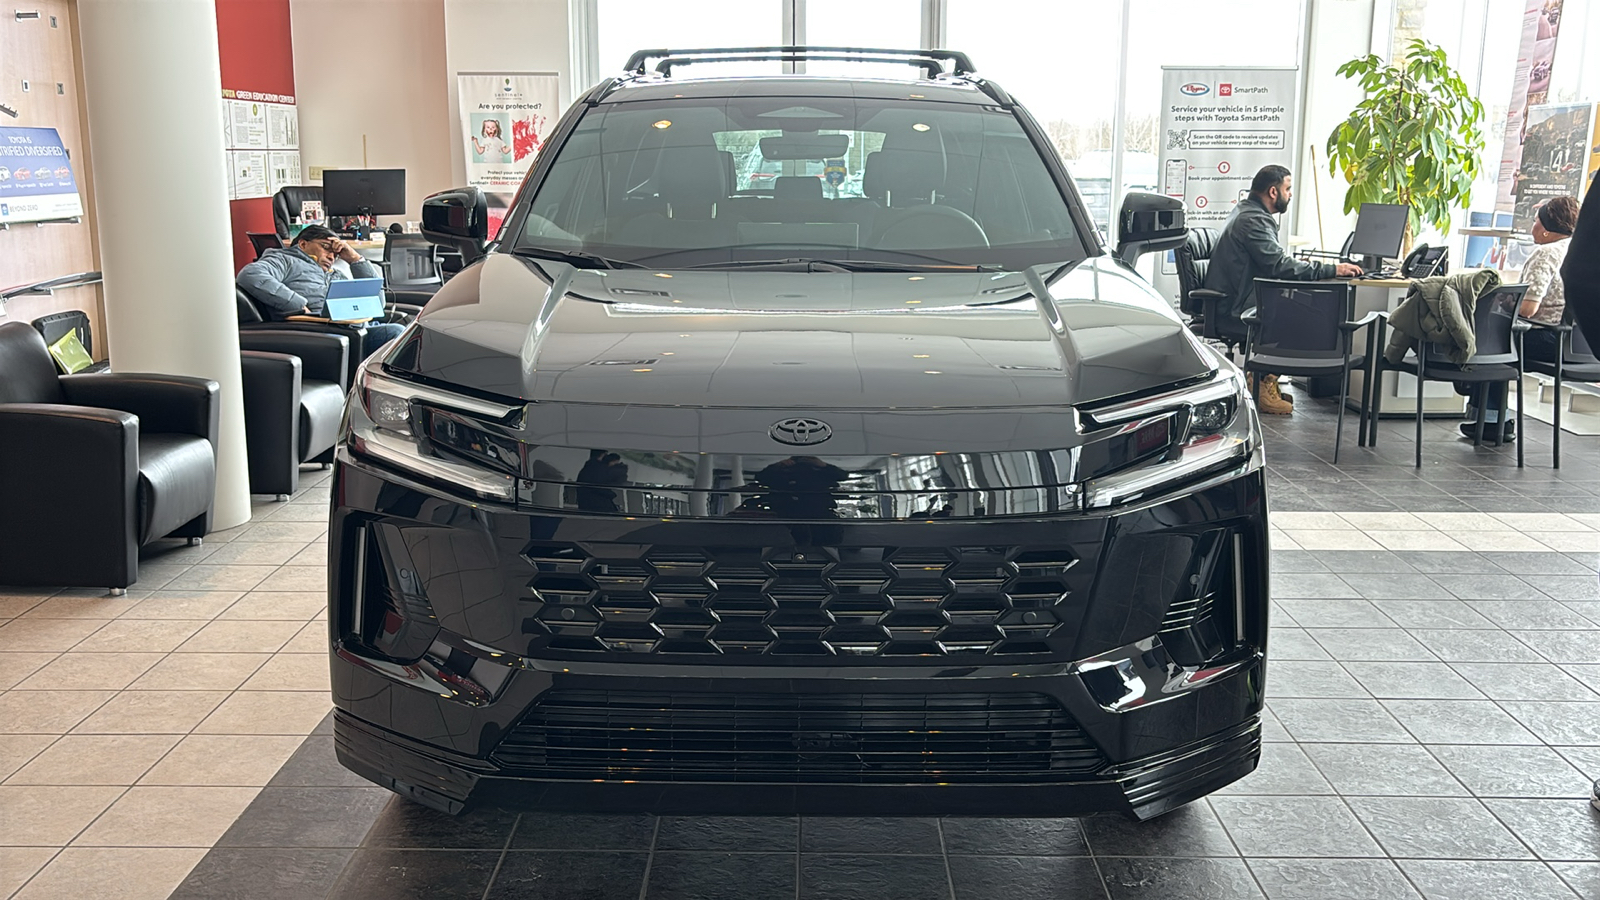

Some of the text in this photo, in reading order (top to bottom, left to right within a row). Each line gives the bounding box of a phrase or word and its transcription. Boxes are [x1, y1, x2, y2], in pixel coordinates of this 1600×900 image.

[236, 90, 252, 99] GREEN
[253, 92, 278, 102] EDUCATION
[279, 95, 294, 103] CENTER
[1260, 106, 1284, 114] simple
[0, 146, 25, 156] TRIFIED
